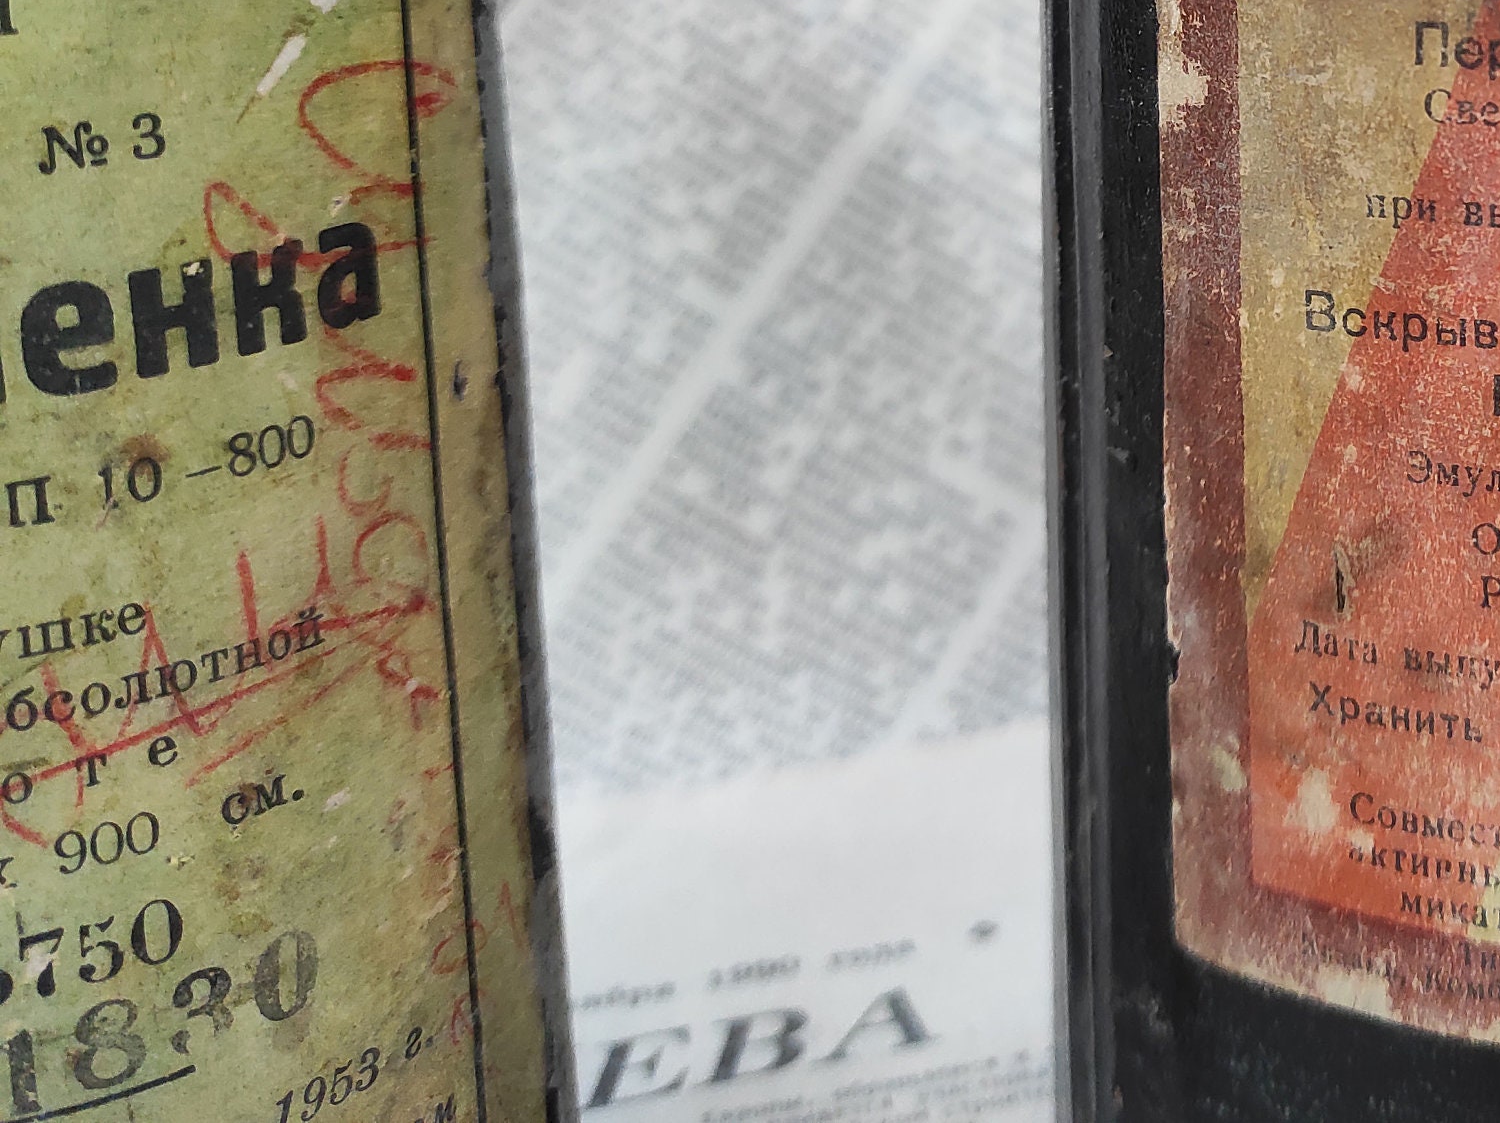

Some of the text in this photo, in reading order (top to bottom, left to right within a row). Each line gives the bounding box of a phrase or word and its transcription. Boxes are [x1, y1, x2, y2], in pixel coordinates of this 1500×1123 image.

[38, 112, 166, 175] № 3
[1365, 192, 1437, 230] при
[0, 221, 381, 405] енка
[1295, 618, 1378, 665] Дата
[1309, 680, 1483, 744] Хранить
[54, 811, 160, 875] 900
[221, 773, 305, 827] см.
